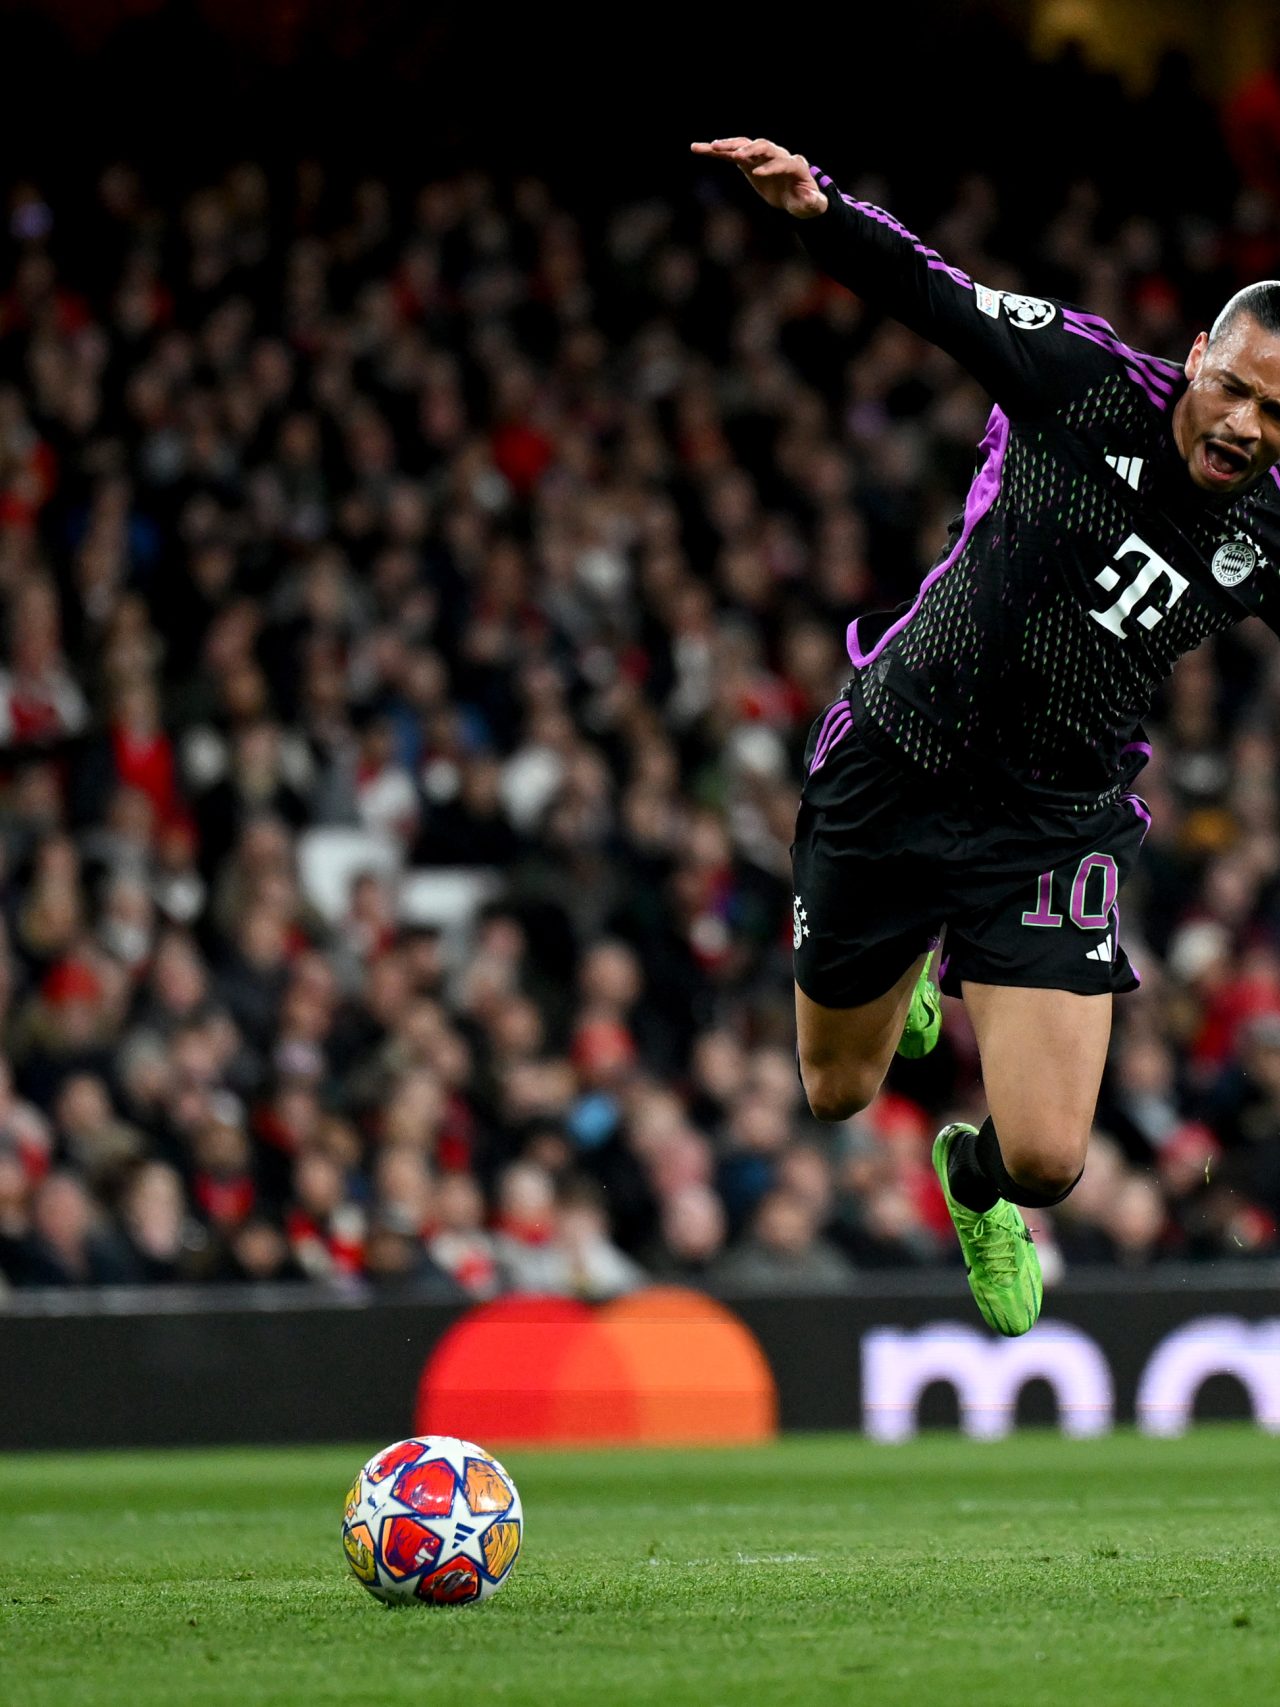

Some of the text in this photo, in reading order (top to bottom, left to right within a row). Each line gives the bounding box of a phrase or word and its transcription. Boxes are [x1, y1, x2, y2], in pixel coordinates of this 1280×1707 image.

[1222, 545, 1252, 568] FC BAYERN
[1021, 852, 1118, 929] 10
